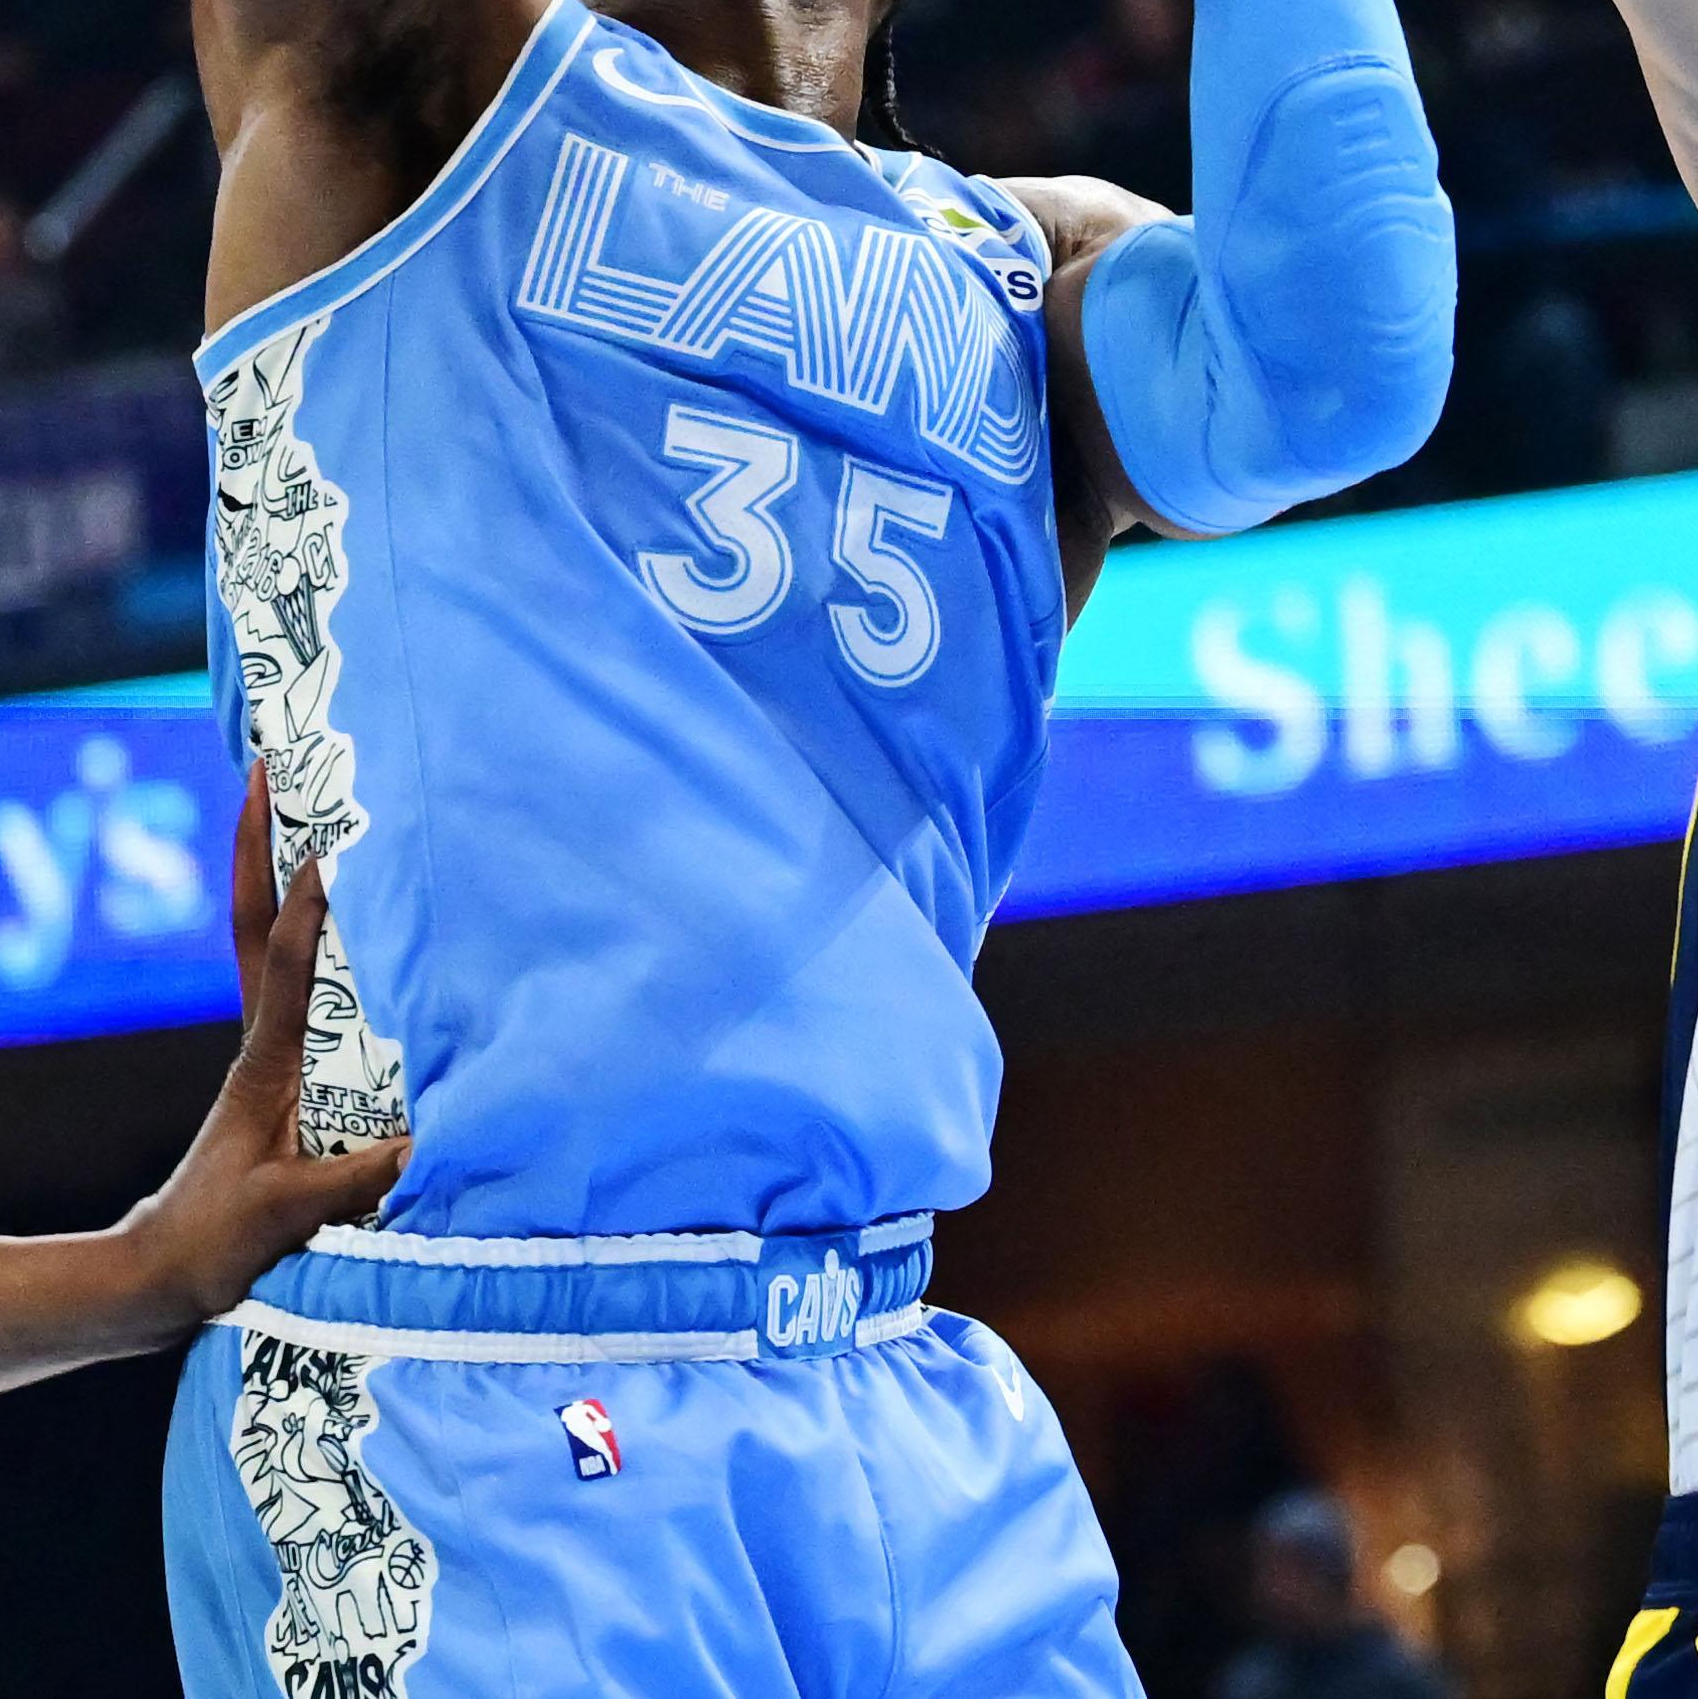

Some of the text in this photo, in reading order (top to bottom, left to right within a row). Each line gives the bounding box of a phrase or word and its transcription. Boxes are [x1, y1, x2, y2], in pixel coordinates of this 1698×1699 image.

[648, 162, 730, 213] THE
[518, 132, 1042, 486] LAND
[638, 404, 954, 688] 35
[766, 1249, 860, 1347] CAVS
